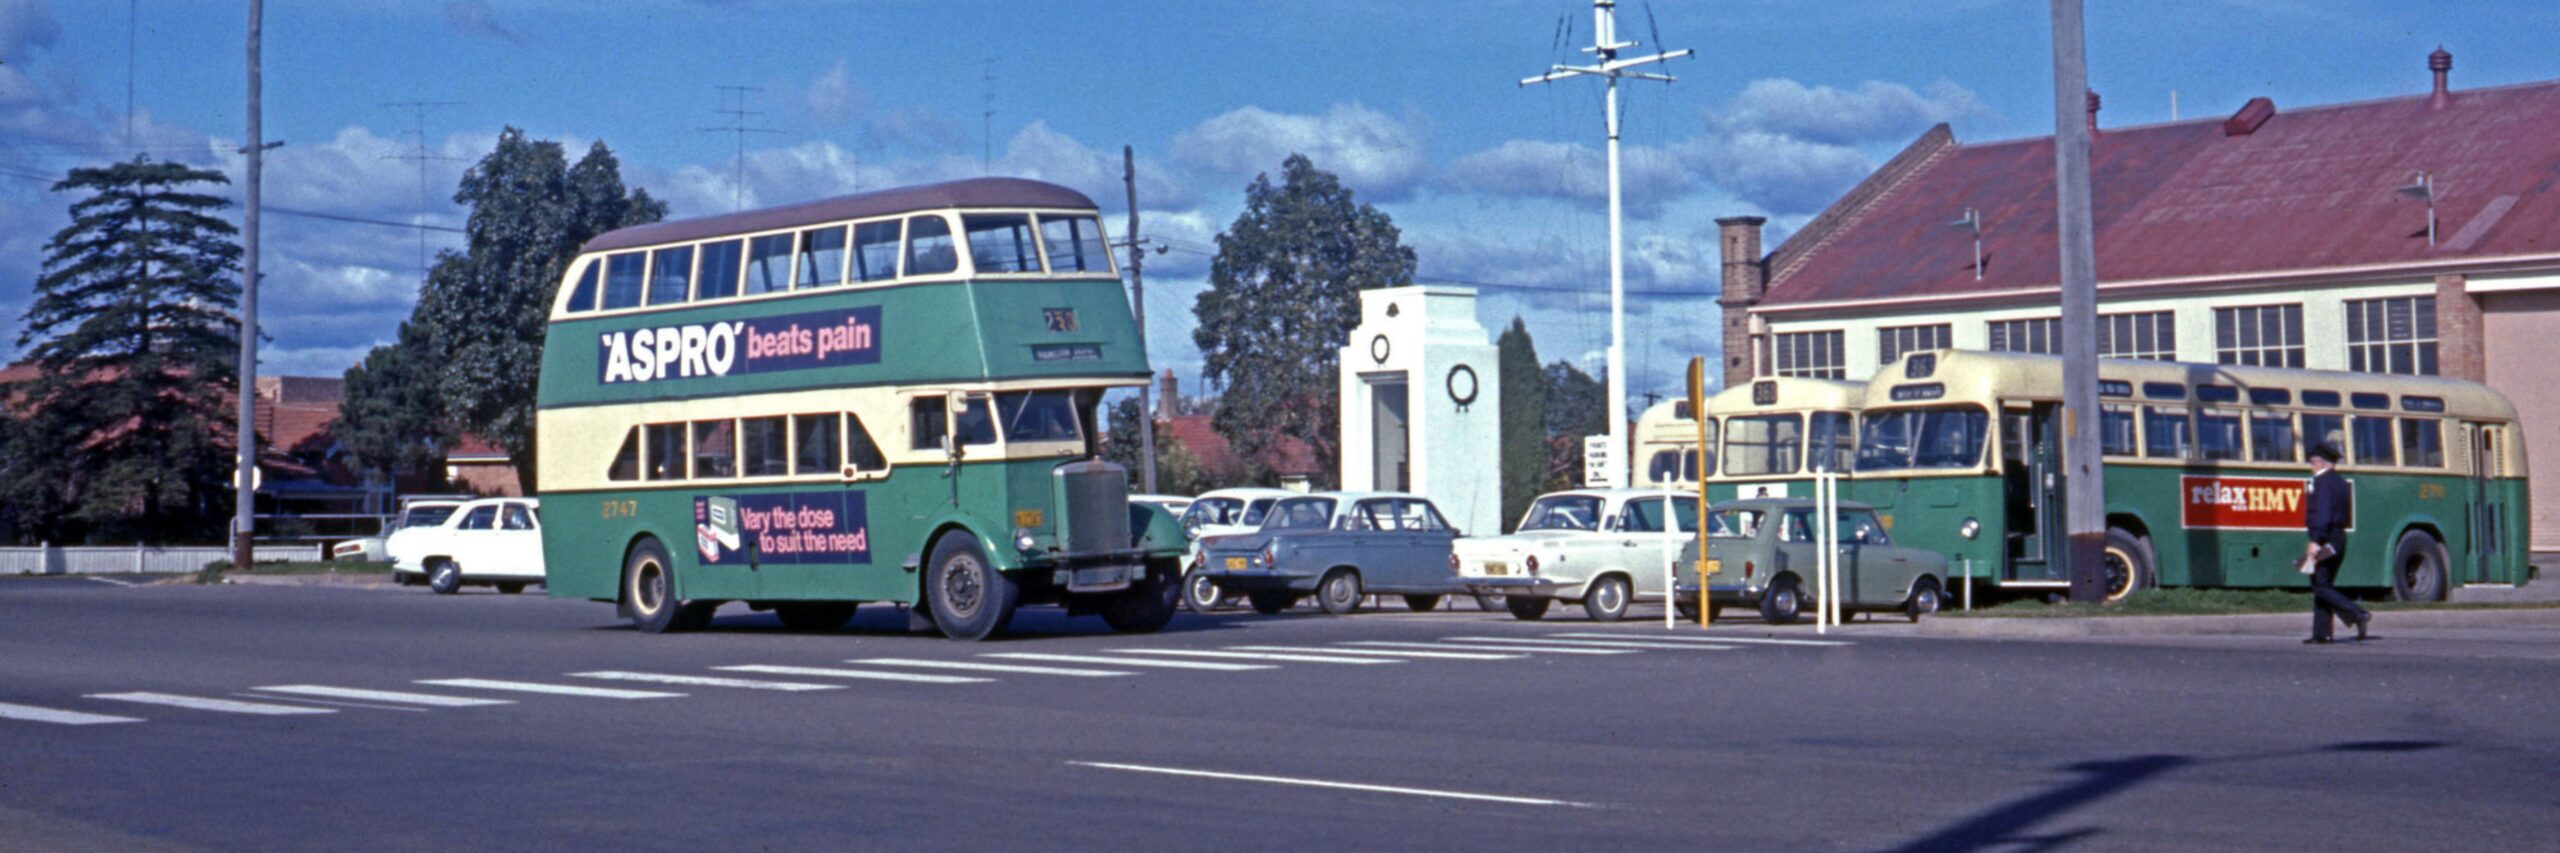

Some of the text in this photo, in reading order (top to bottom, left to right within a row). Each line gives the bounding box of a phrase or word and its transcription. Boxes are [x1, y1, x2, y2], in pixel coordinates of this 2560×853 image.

[747, 323, 812, 358] beats
[817, 316, 871, 360] pain
[602, 499, 638, 518] 2747
[2192, 480, 2247, 504] relax
[2247, 487, 2302, 512] HMV
[740, 507, 770, 533] Vary
[772, 505, 795, 529] the
[797, 505, 834, 528] dose
[759, 527, 867, 553] to suit the need
